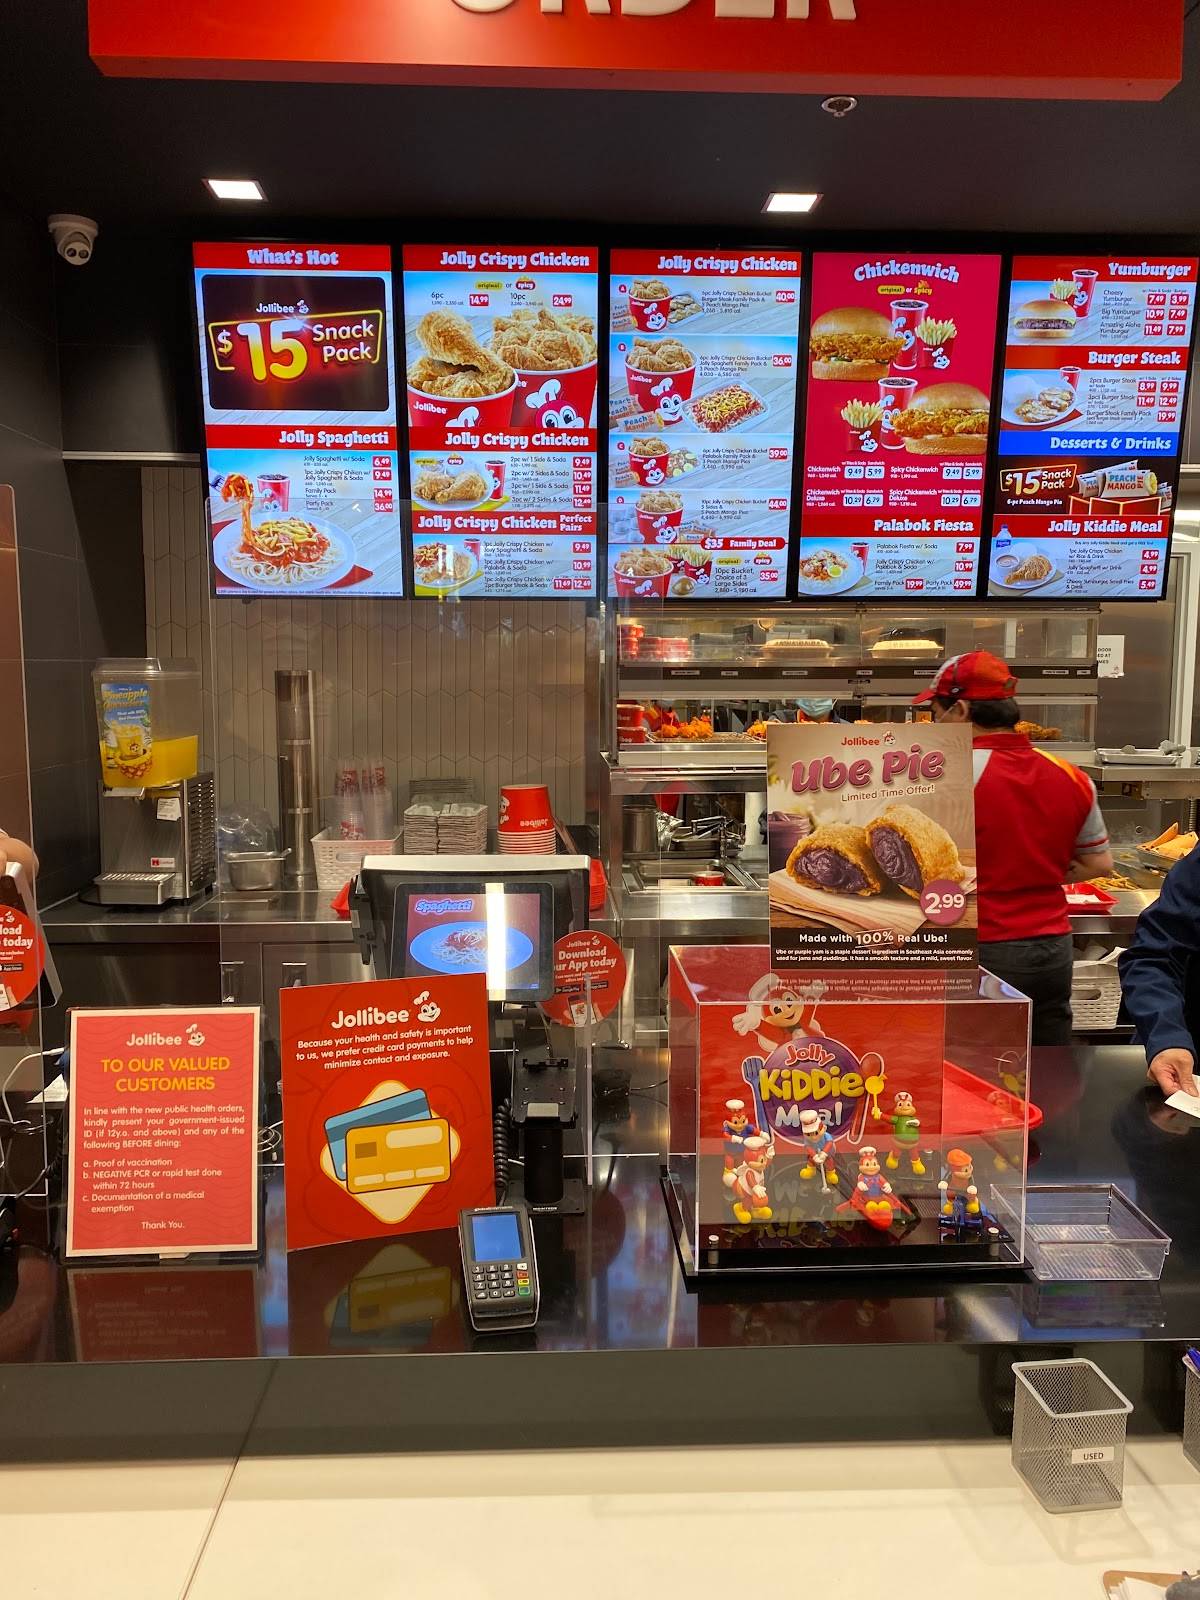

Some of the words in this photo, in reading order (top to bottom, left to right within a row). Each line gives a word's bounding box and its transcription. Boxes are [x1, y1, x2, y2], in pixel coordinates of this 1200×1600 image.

[247, 249, 303, 264] What's
[306, 250, 338, 265] Hot
[441, 251, 476, 269] Jolly
[479, 253, 527, 269] Crispy
[530, 253, 589, 266] Chicken
[658, 256, 691, 272] Jolly
[694, 257, 739, 273] Crispy
[741, 257, 797, 271] Chicken
[1108, 262, 1191, 279] Yumburger
[854, 260, 959, 283] Chickenwich
[470, 296, 488, 304] 14.99
[553, 297, 571, 305] 24.99
[256, 303, 294, 313] Jollibee
[1146, 310, 1163, 318] 10.99
[1171, 311, 1185, 319] 7.49
[312, 320, 374, 342] Snack
[323, 343, 371, 362] Pack
[1088, 352, 1138, 367] Burger
[1141, 352, 1181, 364] Steak
[1139, 383, 1154, 391] 8.99
[1162, 383, 1177, 391] 9.99
[1138, 397, 1154, 405] 11.49
[413, 402, 447, 414] Jollibee
[1158, 412, 1175, 421] 19.99
[279, 430, 314, 447] Jolly
[318, 430, 389, 447] Spaghetti
[445, 432, 480, 448] Jolly
[483, 433, 529, 449] Crispy
[532, 434, 588, 446] Chicken
[1051, 437, 1108, 449] Desserts
[1111, 438, 1122, 448] &
[1126, 438, 1172, 449] Drinks
[770, 450, 787, 458] 39.00
[375, 458, 389, 466] 6.49
[575, 459, 590, 467] 9.49
[375, 471, 389, 479] 9.49
[847, 468, 862, 476] 9.49
[868, 468, 881, 476] 5.99
[945, 469, 959, 477] 9.49
[965, 469, 979, 477] 5.99
[1042, 469, 1071, 480] Snack
[1041, 479, 1065, 489] Pack
[374, 490, 392, 498] 14.99
[418, 516, 451, 530] Jolly
[454, 517, 499, 530] Crispy
[502, 517, 557, 528] Chicken
[874, 519, 930, 531] Palabok
[934, 519, 973, 531] Fiesta
[1048, 520, 1081, 535] Jolly
[1084, 521, 1127, 532] Kiddie
[1130, 520, 1162, 532] Meal
[705, 538, 723, 548] $35
[730, 538, 757, 548] Family
[758, 538, 776, 547] Deal
[959, 543, 972, 551] 7.99
[956, 562, 972, 570] 10.99
[1141, 581, 1155, 589] 5.49
[841, 737, 880, 746] Jollibee
[791, 756, 872, 794] Ube
[881, 744, 945, 785] Pie
[841, 791, 877, 802] Limited
[880, 788, 903, 798] Time
[907, 785, 934, 795] Offer!
[415, 899, 473, 914] Spaghetti
[924, 893, 964, 914] 2.99
[3, 936, 33, 949] today
[567, 940, 590, 948] Jollibee
[800, 934, 827, 942] Made
[830, 934, 852, 942] with
[856, 931, 894, 945] 100%
[898, 934, 920, 942] Real
[923, 934, 948, 942] Ube!
[558, 947, 606, 960] Download
[553, 961, 566, 971] ur
[569, 960, 588, 971] App
[590, 957, 617, 968] today
[332, 1007, 409, 1029] Jollibee
[127, 1032, 182, 1046] Jollibee
[298, 1039, 332, 1048] Because
[335, 1037, 353, 1048] your
[355, 1034, 380, 1043] health
[383, 1033, 398, 1041] and
[400, 1029, 423, 1039] safety
[426, 1028, 432, 1036] is
[434, 1025, 471, 1036] important
[296, 1053, 304, 1061] to
[307, 1051, 319, 1059] us,
[321, 1050, 334, 1058] we
[336, 1047, 360, 1058] prefer
[362, 1044, 385, 1053] credit
[387, 1042, 404, 1051] card
[407, 1038, 445, 1051] payments
[447, 1038, 454, 1046] to
[457, 1036, 473, 1046] help
[324, 1059, 361, 1070] minimize
[364, 1056, 393, 1065] contact
[395, 1054, 410, 1062] and
[412, 1050, 450, 1061] exposure.
[784, 1044, 835, 1066] Jolly
[102, 1059, 123, 1072] TO
[128, 1058, 164, 1072] OUR
[169, 1057, 230, 1071] VALUED
[116, 1077, 215, 1092] CUSTOMERS
[94, 1107, 108, 1115] line
[130, 1106, 142, 1114] the
[165, 1105, 188, 1115] public
[218, 1104, 244, 1113] orders,
[775, 1101, 842, 1127] Mal
[84, 1119, 107, 1127] kindly
[112, 1118, 142, 1127] present
[147, 1118, 164, 1126] your
[169, 1116, 245, 1125] government-issued
[142, 1221, 166, 1229] Thank
[168, 1220, 184, 1229] You.
[1084, 1453, 1104, 1461] USED
